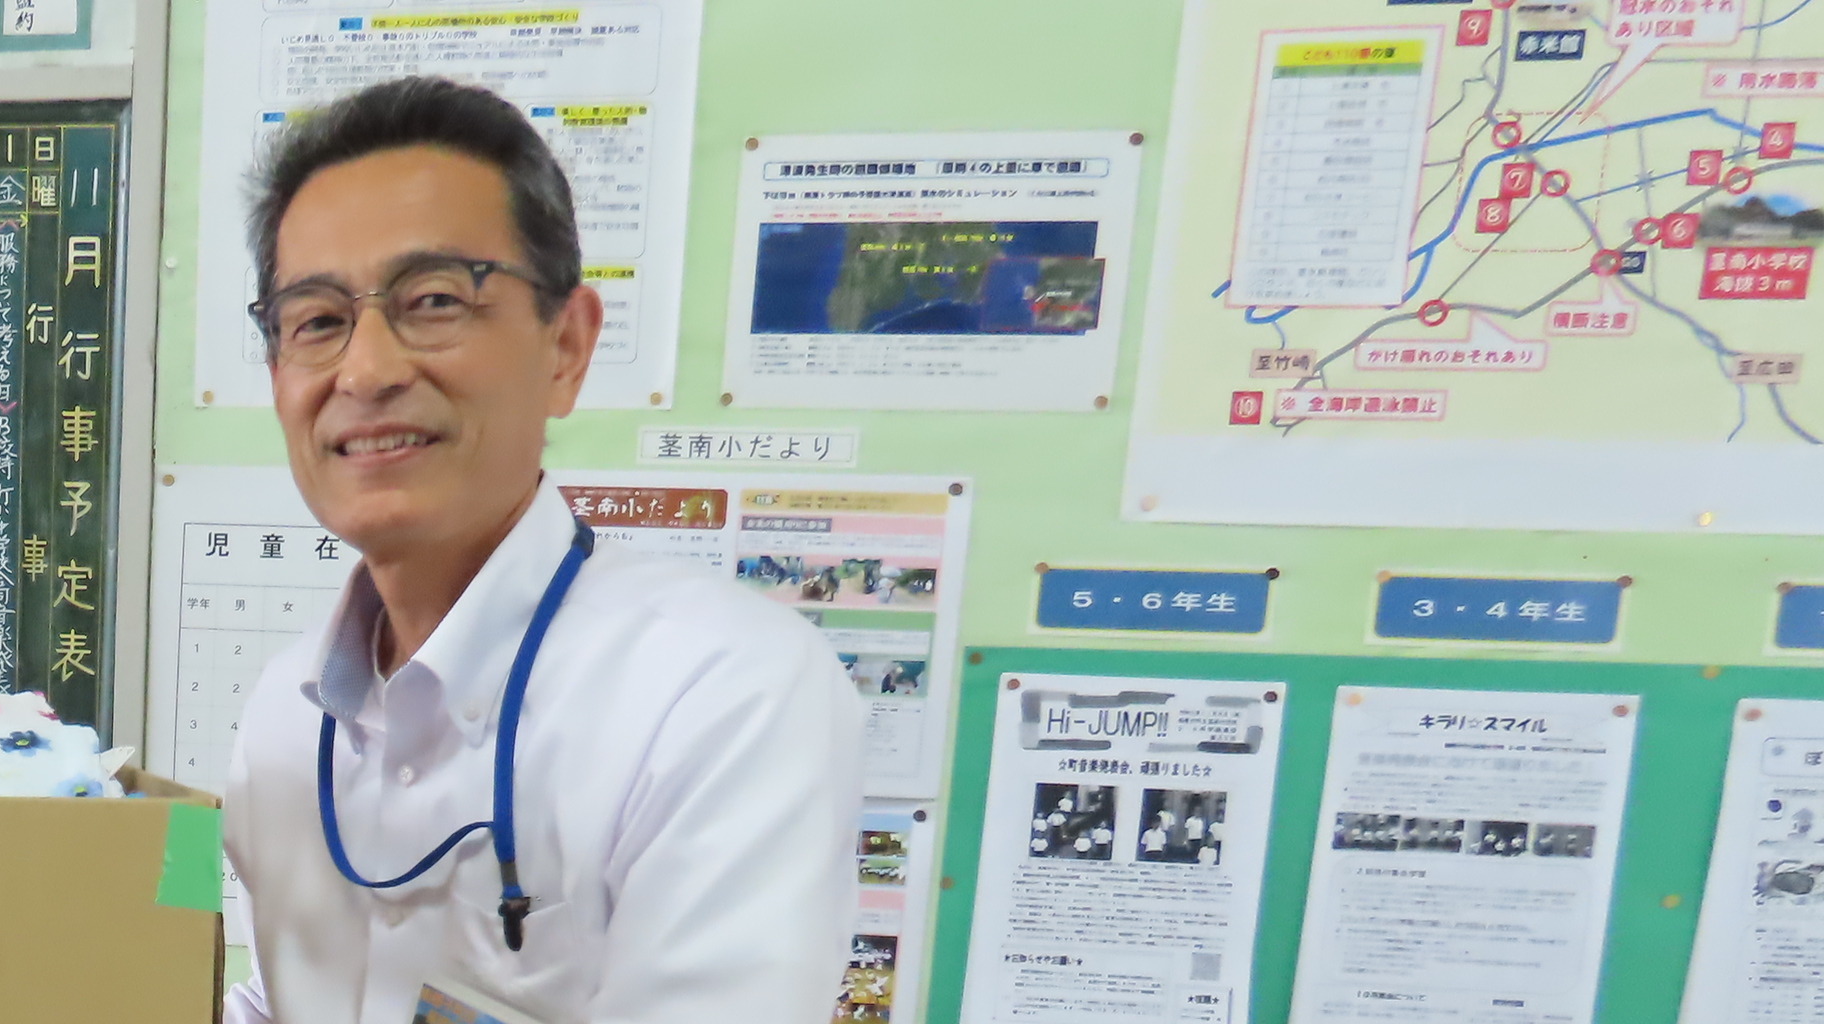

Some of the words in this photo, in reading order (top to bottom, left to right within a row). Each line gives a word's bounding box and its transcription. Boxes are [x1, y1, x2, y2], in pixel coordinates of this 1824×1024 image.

[34, 136, 56, 161] 日
[31, 175, 58, 207] 曜
[657, 431, 835, 462] 茎南小だより
[187, 597, 211, 610] 学年
[235, 599, 247, 612] 男
[282, 601, 294, 613] 女
[1072, 590, 1237, 614] 5・6年生
[1412, 599, 1587, 622] 3・4年生
[194, 644, 200, 654] 1
[234, 645, 242, 656] 2
[191, 682, 199, 692] 2
[233, 683, 240, 694] 2
[190, 720, 197, 730] 3
[231, 721, 238, 731] 4
[188, 758, 195, 767] 4
